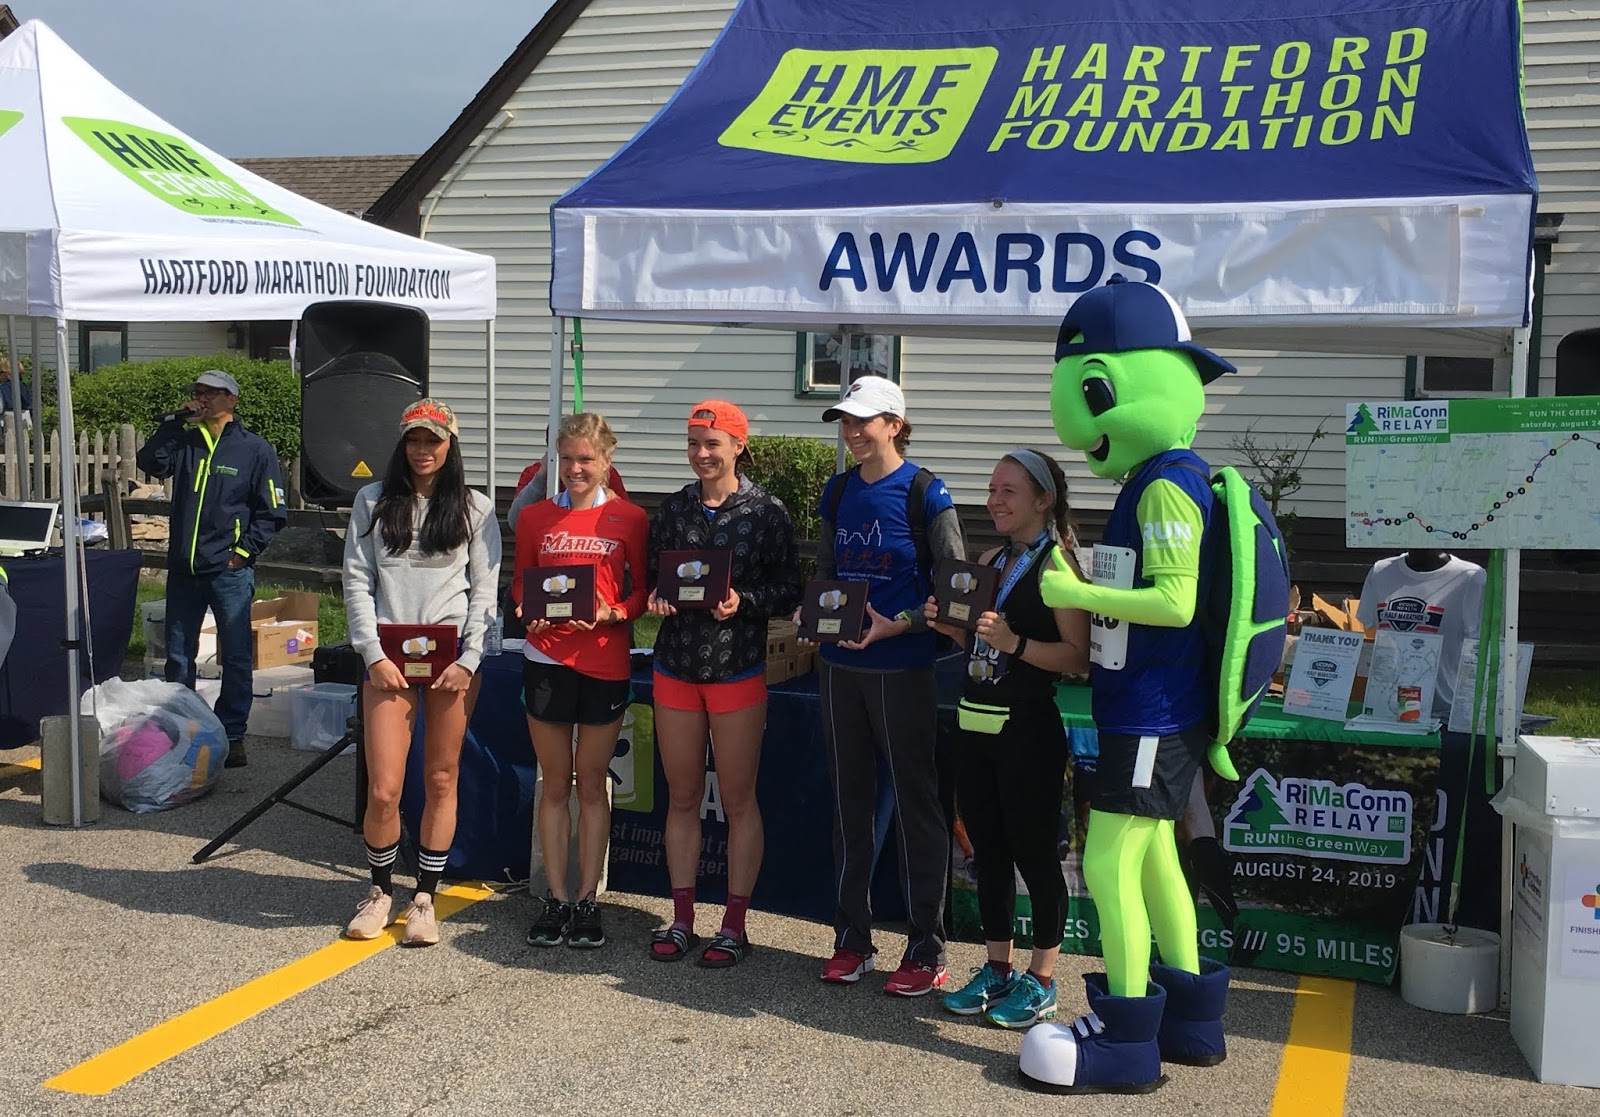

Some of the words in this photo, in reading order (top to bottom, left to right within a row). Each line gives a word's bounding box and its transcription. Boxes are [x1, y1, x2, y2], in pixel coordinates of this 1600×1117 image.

[1021, 27, 1428, 83] HARTFORD
[788, 63, 972, 107] HMF
[1005, 63, 1422, 119] MARATHON
[767, 103, 948, 137] EVENTS
[986, 100, 1416, 153] FOUNDATION
[91, 130, 212, 178] HMF
[137, 170, 257, 205] EVENTS
[819, 230, 1163, 294] AWARDS
[139, 258, 249, 296] HARTFORD
[254, 260, 349, 296] MARATHON
[355, 264, 451, 300] FOUNDATION
[1377, 405, 1447, 419] RiMaConn
[1382, 419, 1433, 431] RELAY
[1520, 421, 1558, 429] saturday,
[1560, 420, 1589, 428] august
[1529, 410, 1547, 418] RUN
[1568, 409, 1597, 417] GREEN
[541, 530, 619, 555] MARIST
[1143, 521, 1193, 542] RUN
[1304, 632, 1336, 645] THANK
[1338, 636, 1360, 647] YOU
[1285, 783, 1407, 813] RiMaConn
[1295, 807, 1380, 832] RELAY
[1243, 832, 1388, 857] RUNtheGreenWay
[1233, 861, 1306, 880] AUGUST
[1311, 867, 1341, 886] 24,
[1348, 871, 1396, 889] 2019
[1570, 925, 1600, 936] FINISH
[1275, 933, 1306, 955] 95
[1316, 938, 1394, 968] MILES
